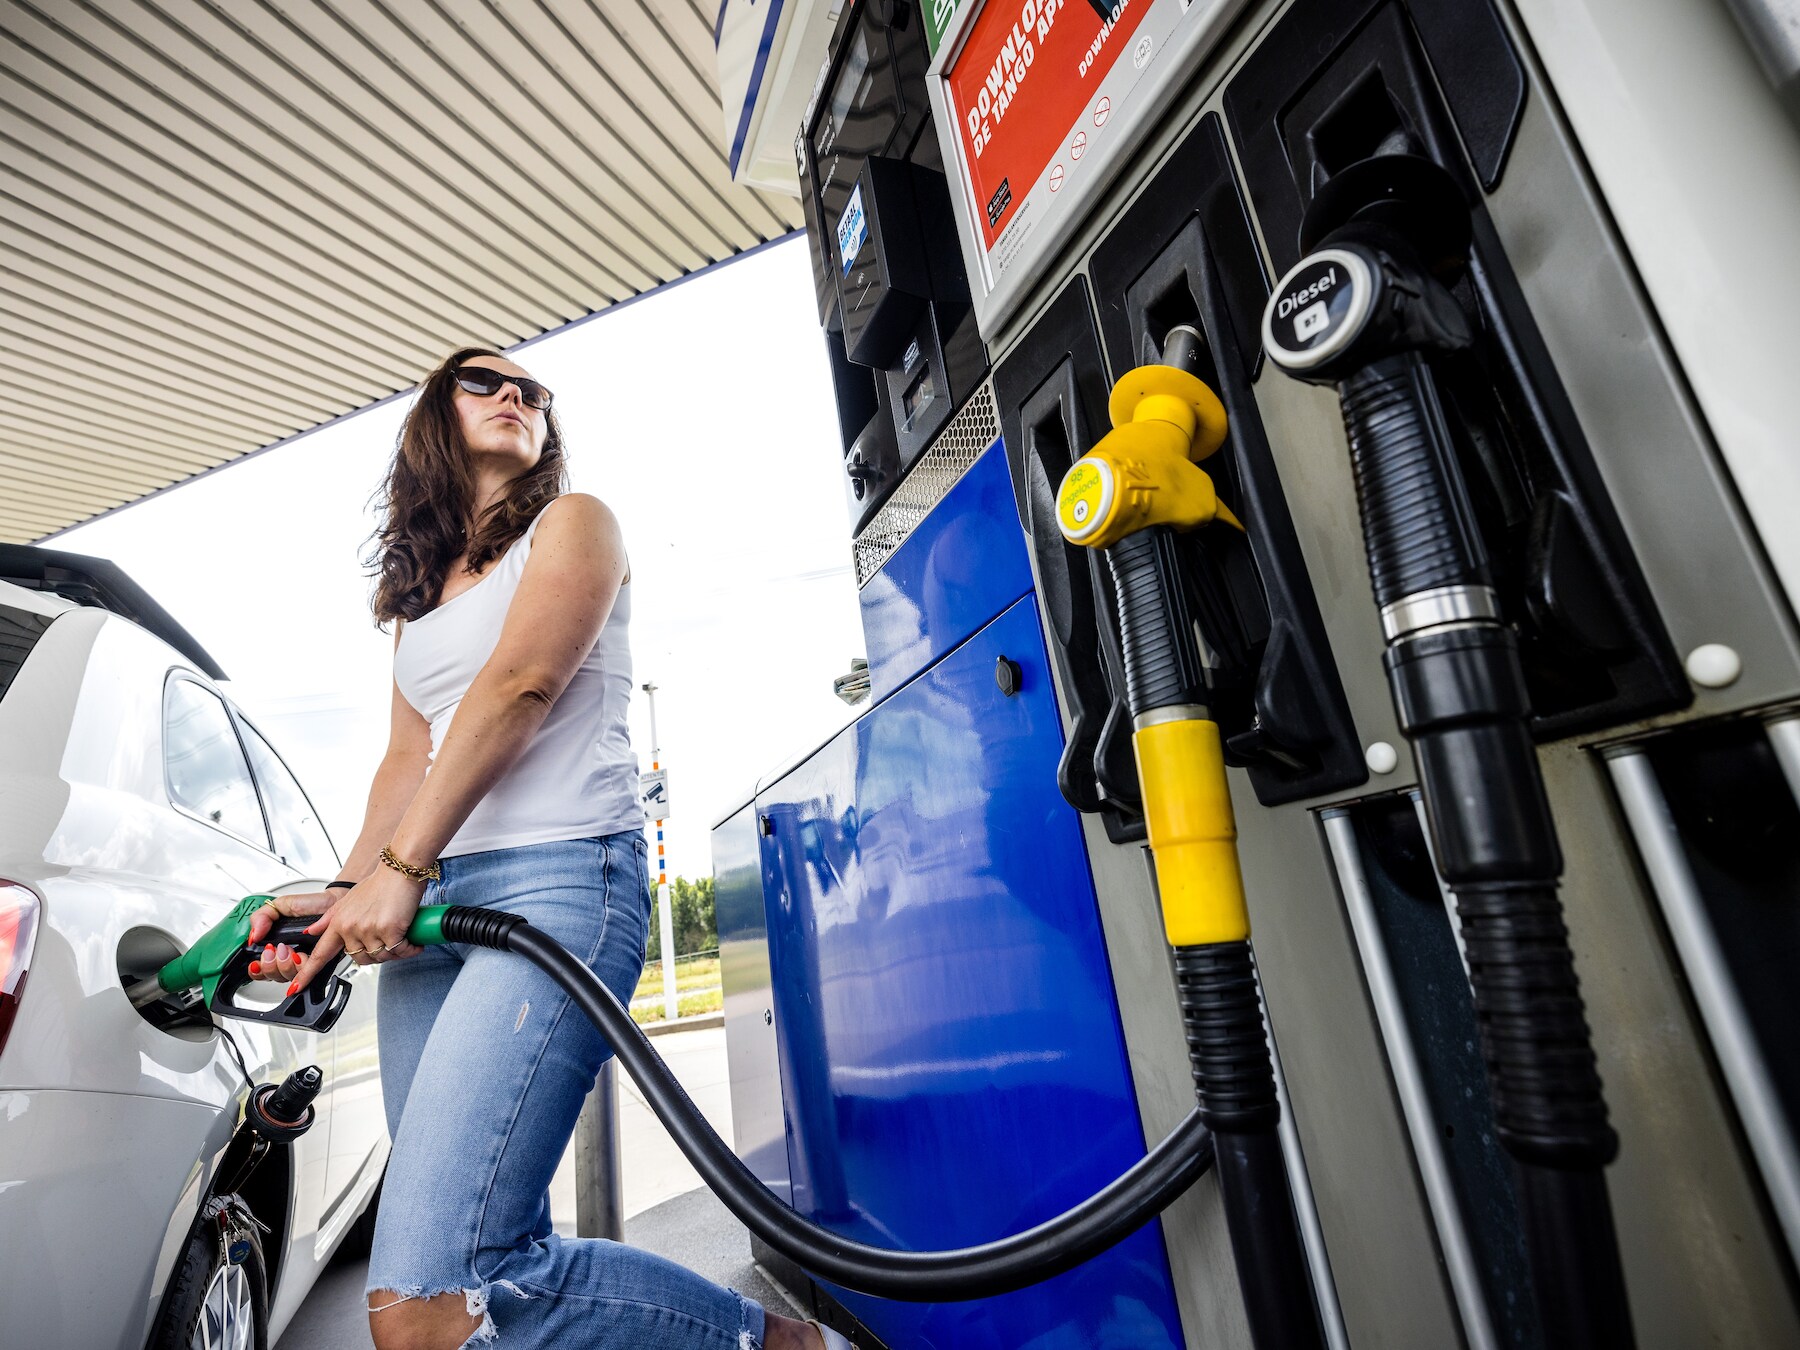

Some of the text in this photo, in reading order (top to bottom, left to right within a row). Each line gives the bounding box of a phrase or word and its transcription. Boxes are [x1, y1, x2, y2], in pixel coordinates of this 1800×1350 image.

[1078, 0, 1130, 78] DOWNLOA
[973, 119, 992, 159] DE
[991, 40, 1035, 124] TANGO
[840, 203, 856, 241] BETAAL
[1278, 267, 1336, 319] Diesel
[1304, 313, 1318, 328] B7
[1070, 468, 1083, 487] 98
